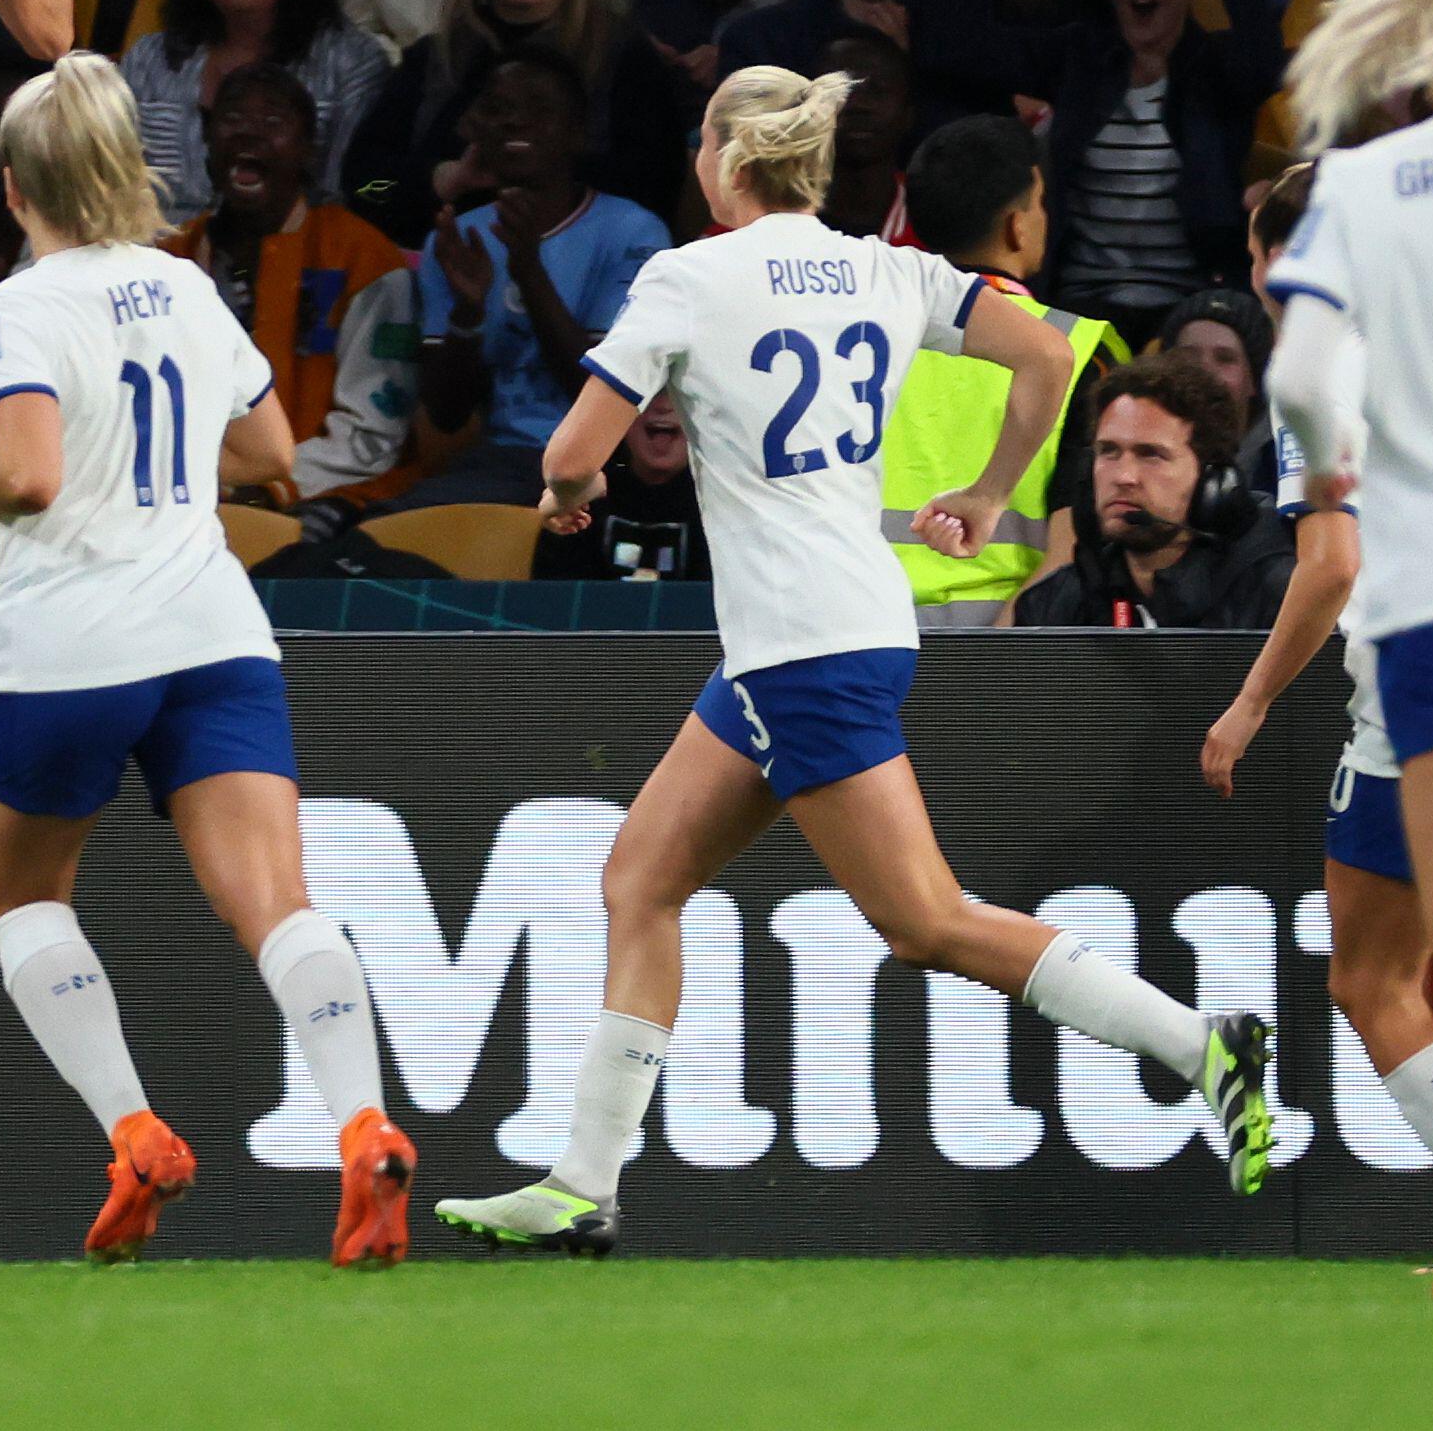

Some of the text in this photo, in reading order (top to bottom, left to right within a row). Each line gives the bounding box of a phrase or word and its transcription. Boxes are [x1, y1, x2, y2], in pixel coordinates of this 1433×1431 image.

[766, 258, 857, 296] RUSSO
[120, 353, 190, 507] 11
[749, 320, 891, 479] 23
